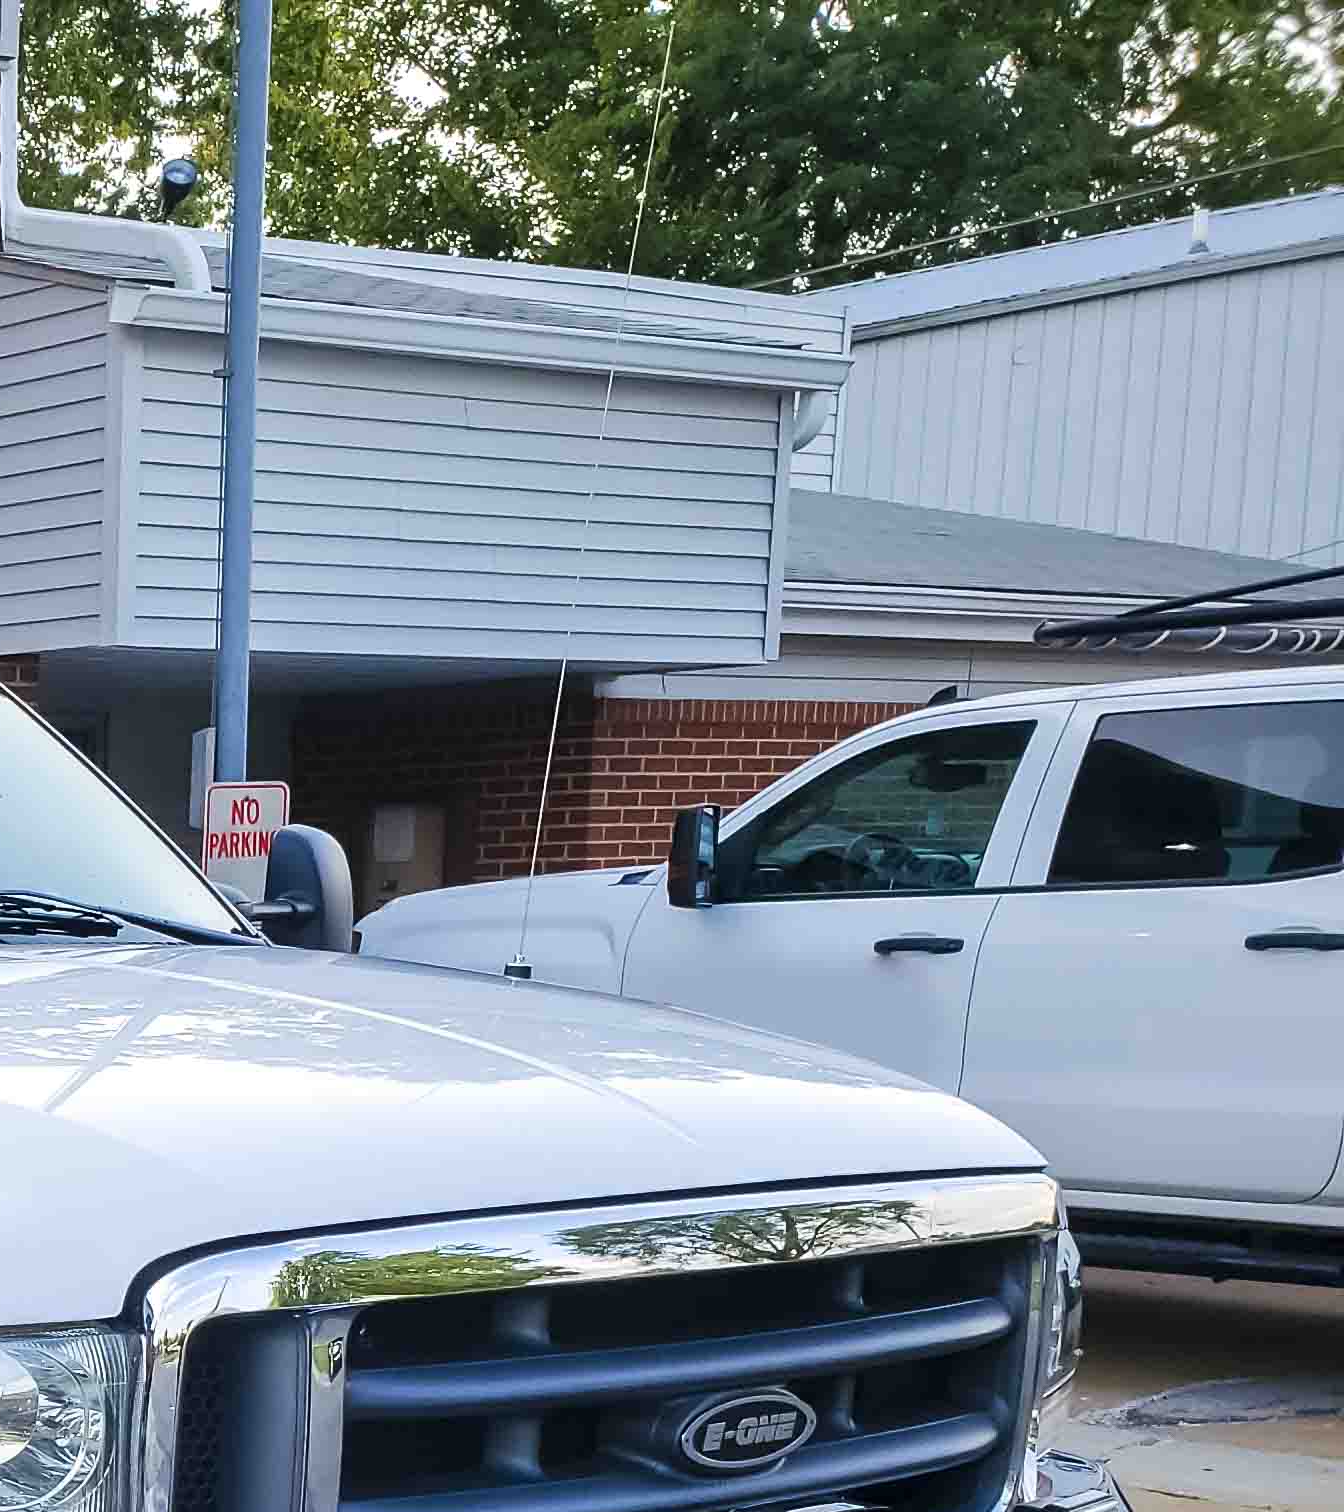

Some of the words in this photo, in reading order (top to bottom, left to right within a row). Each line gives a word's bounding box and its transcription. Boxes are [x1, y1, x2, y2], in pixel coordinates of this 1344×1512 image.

[231, 799, 260, 826] NO
[209, 831, 271, 860] PARKIN
[702, 1410, 798, 1452] E-ONE
